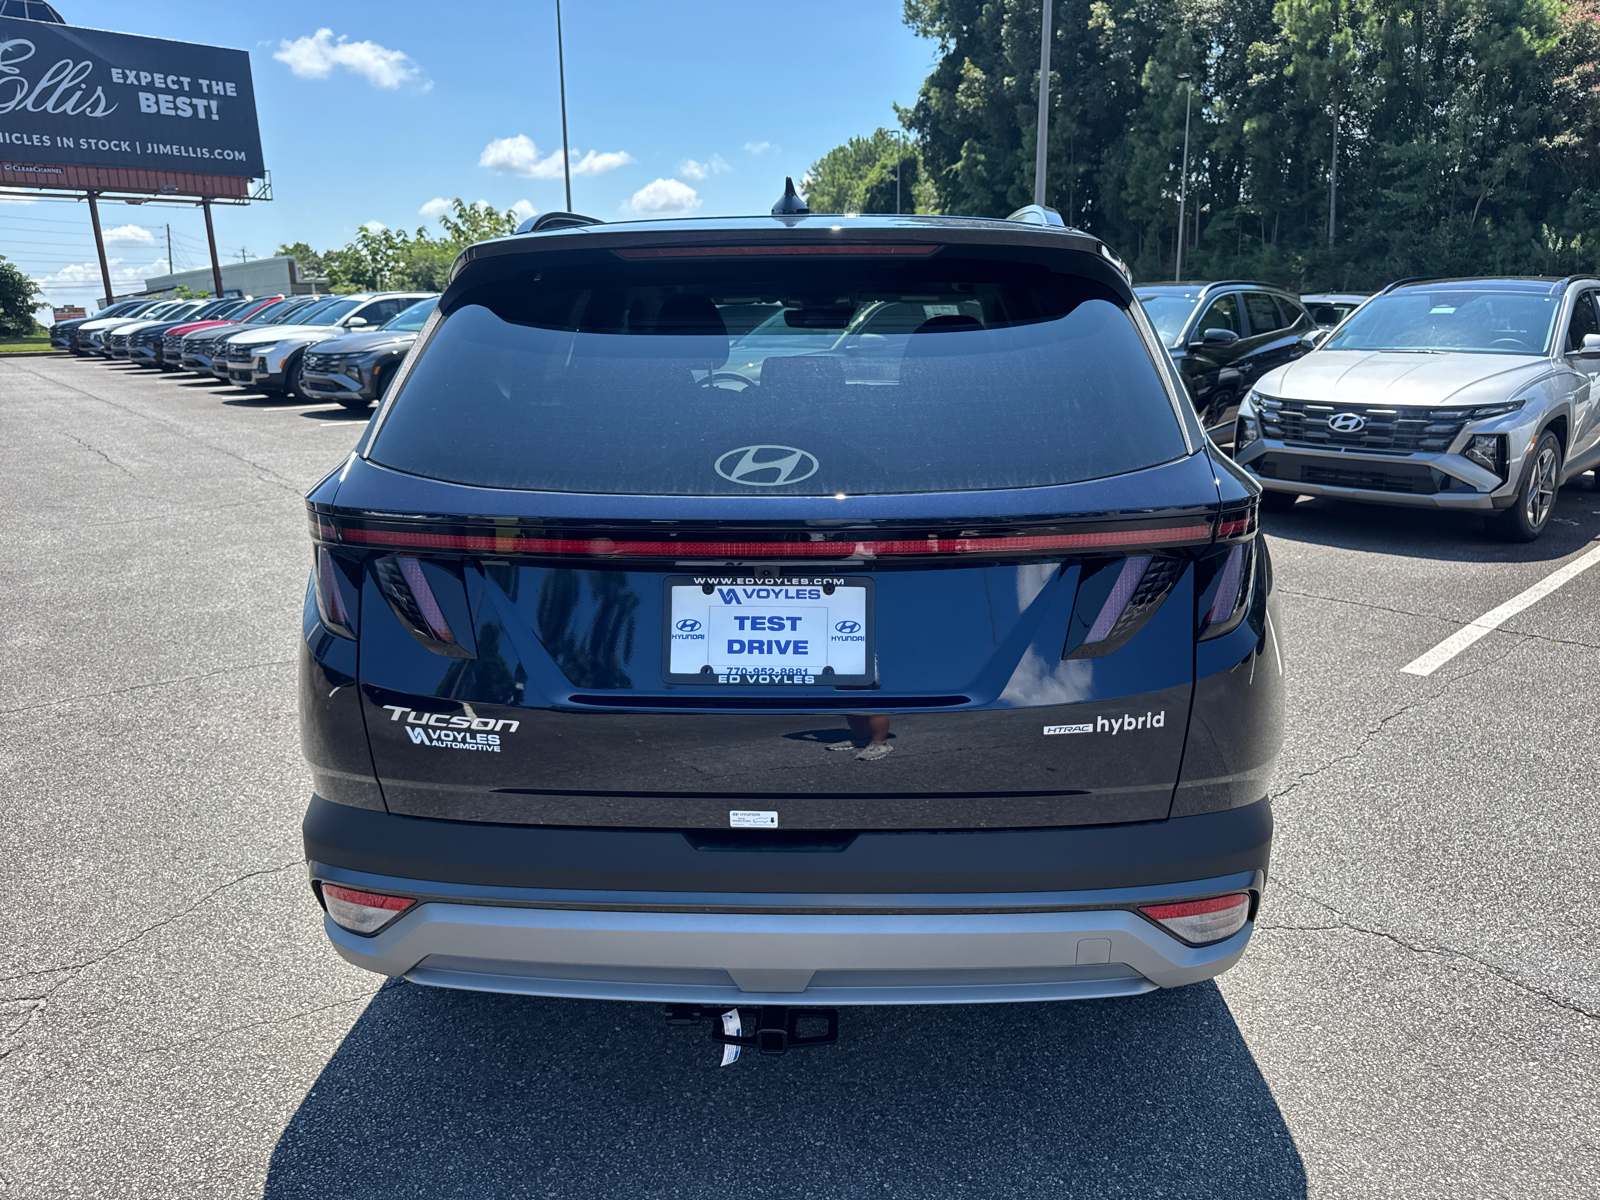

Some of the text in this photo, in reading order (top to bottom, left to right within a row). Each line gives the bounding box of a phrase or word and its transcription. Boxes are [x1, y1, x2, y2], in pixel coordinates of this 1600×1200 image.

[110, 67, 237, 97] EXPECT THE
[138, 91, 220, 121] BEST!
[56, 136, 75, 149] IN
[80, 138, 132, 153] STOCK
[146, 142, 247, 162] JIMELLIS.COM
[693, 577, 845, 585] WWW.EDVOYLES.COM
[742, 588, 821, 600] VOYLES
[733, 616, 802, 632] TEST
[727, 640, 809, 655] DRIVE
[726, 667, 808, 675] 770-952-8881
[718, 675, 815, 684] ED VOYLES
[1047, 711, 1165, 736] HTRAC hybrid
[428, 728, 501, 745] VOYLES
[431, 740, 501, 752] AUTOMOTIVE
